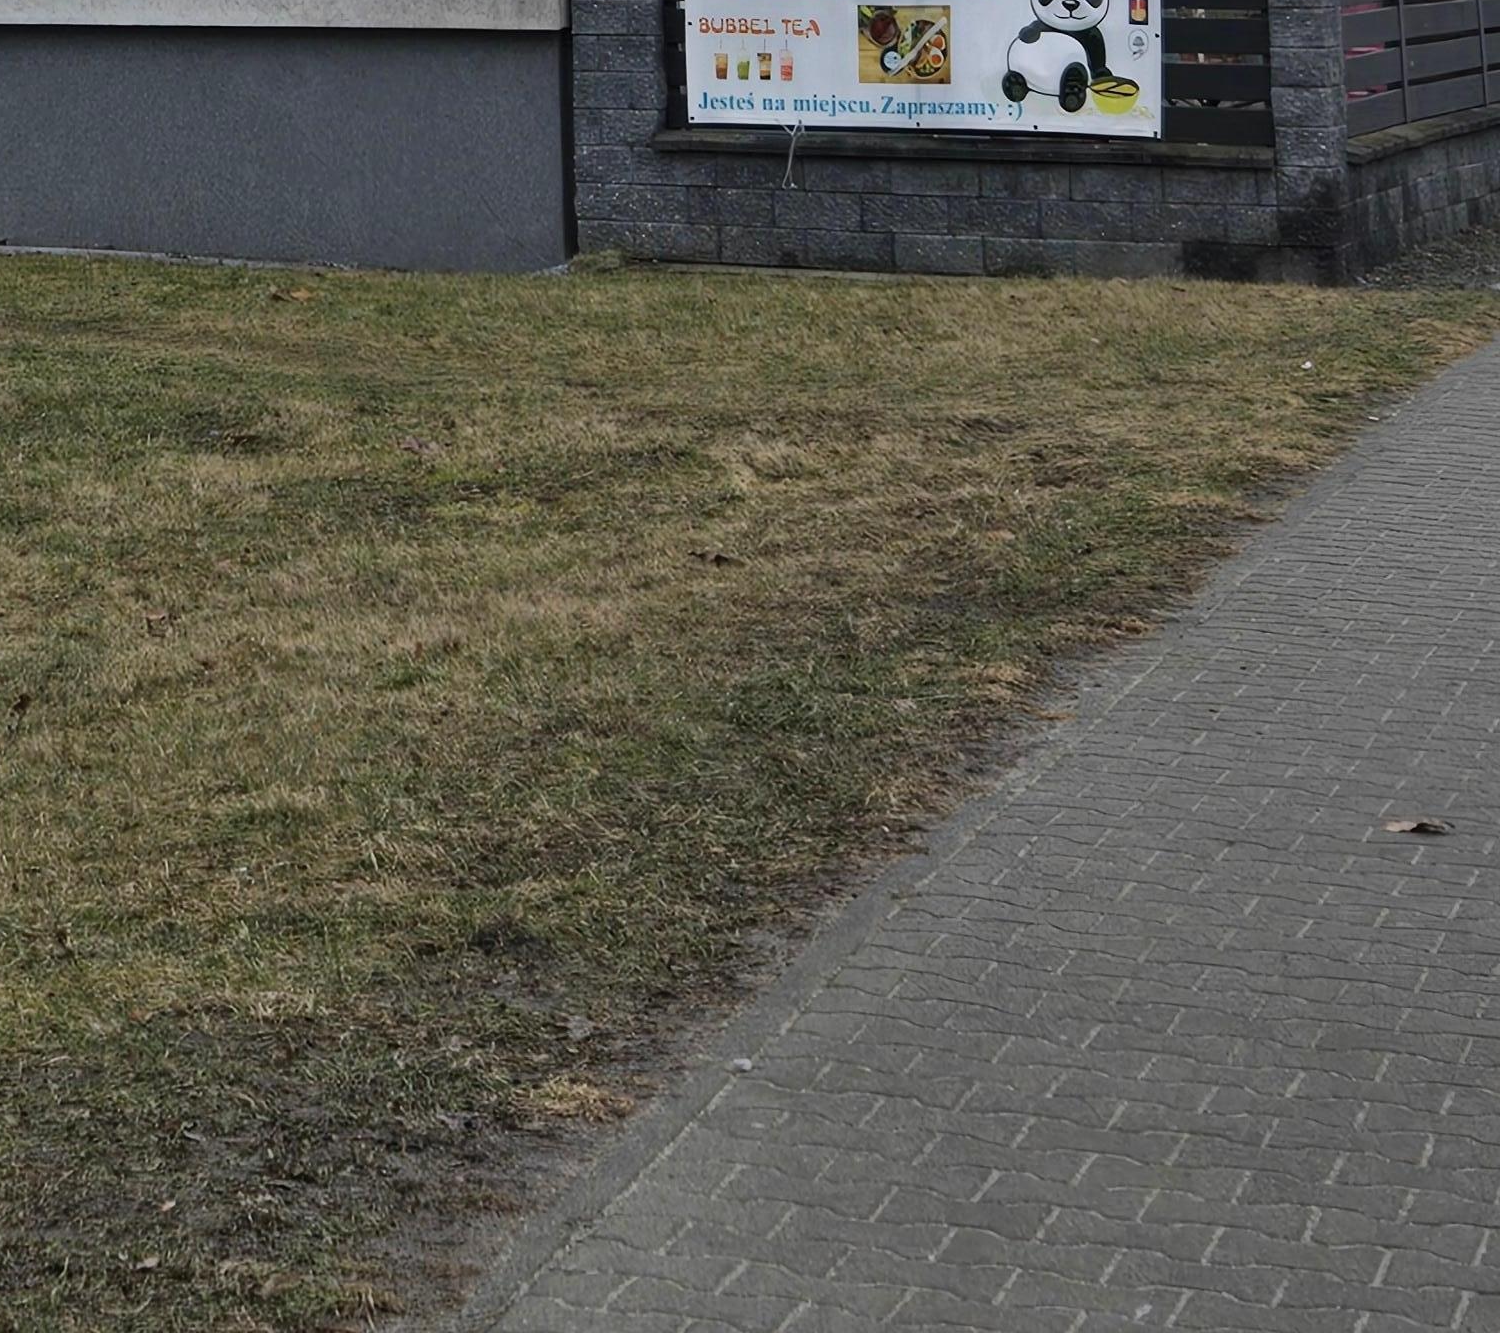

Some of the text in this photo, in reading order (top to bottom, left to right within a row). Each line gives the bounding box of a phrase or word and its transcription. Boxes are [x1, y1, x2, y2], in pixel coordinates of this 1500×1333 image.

[781, 18, 821, 37] TEA
[698, 91, 755, 111] Jesteś
[762, 97, 786, 111] na
[793, 94, 877, 117] miejscu.
[881, 95, 999, 121] Zapraszamy
